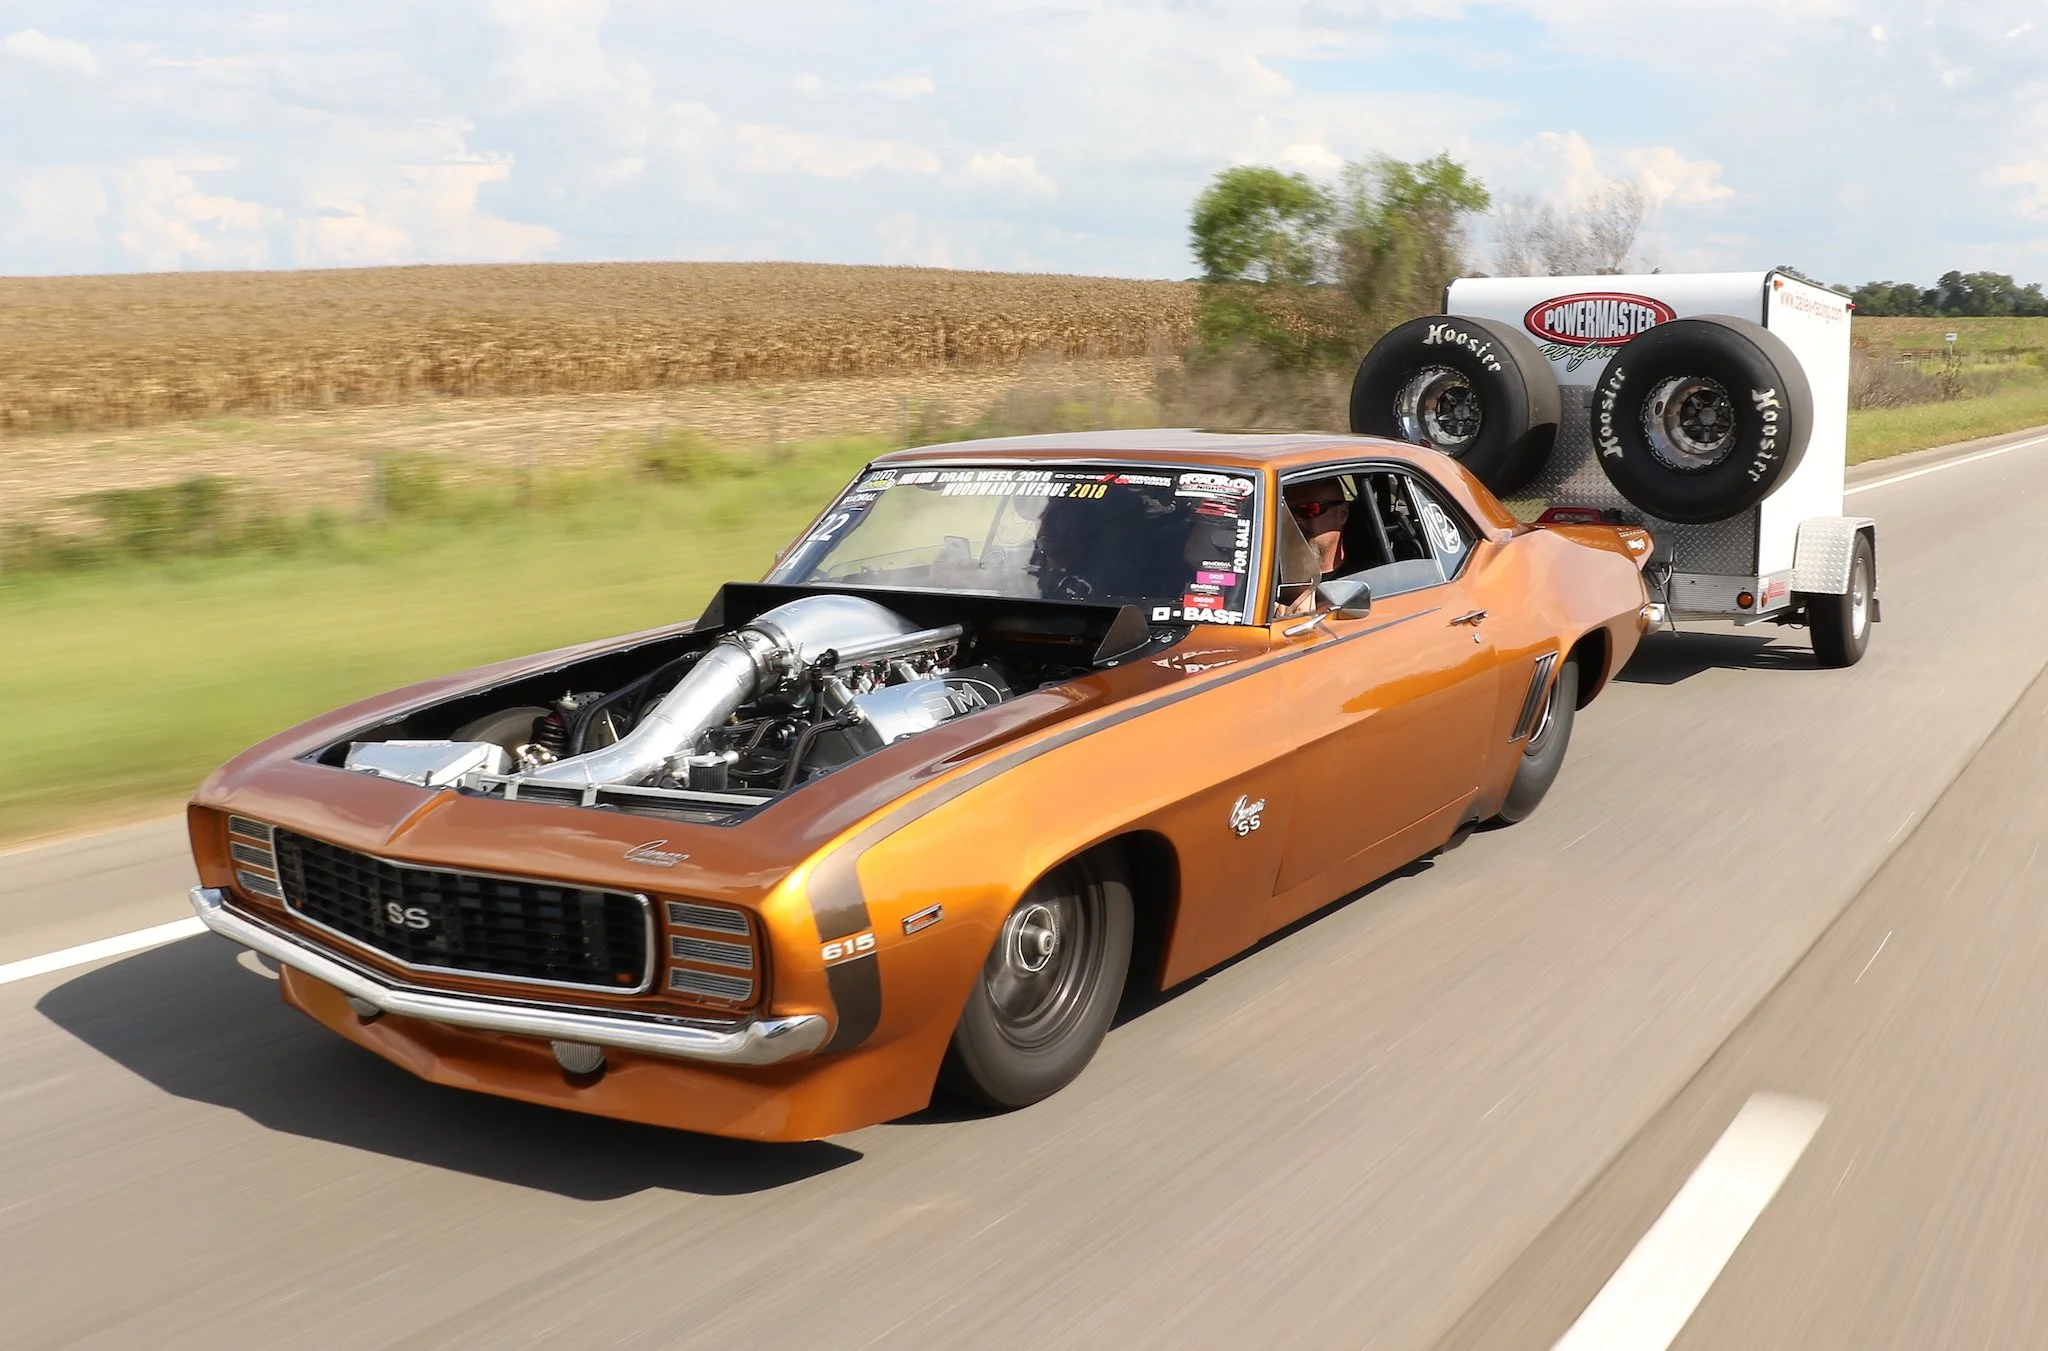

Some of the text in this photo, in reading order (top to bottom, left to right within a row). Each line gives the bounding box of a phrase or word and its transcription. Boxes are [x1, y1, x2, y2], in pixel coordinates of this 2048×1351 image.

[1544, 300, 1657, 338] POWERMASTER
[1422, 323, 1502, 372] Hoosier
[1598, 367, 1625, 457] Hoosier
[1748, 388, 1783, 482] Hoosier
[937, 472, 975, 482] DRAG
[977, 471, 1016, 481] WEEK
[1016, 471, 1053, 482] 2018
[941, 482, 1108, 499] WOODWARD AVENUE 2018
[806, 513, 850, 541] 22
[1232, 519, 1251, 574] FOR SALE
[1183, 607, 1243, 625] BASF
[1237, 814, 1261, 836] SS
[387, 901, 430, 929] SS
[822, 932, 876, 961] 615
